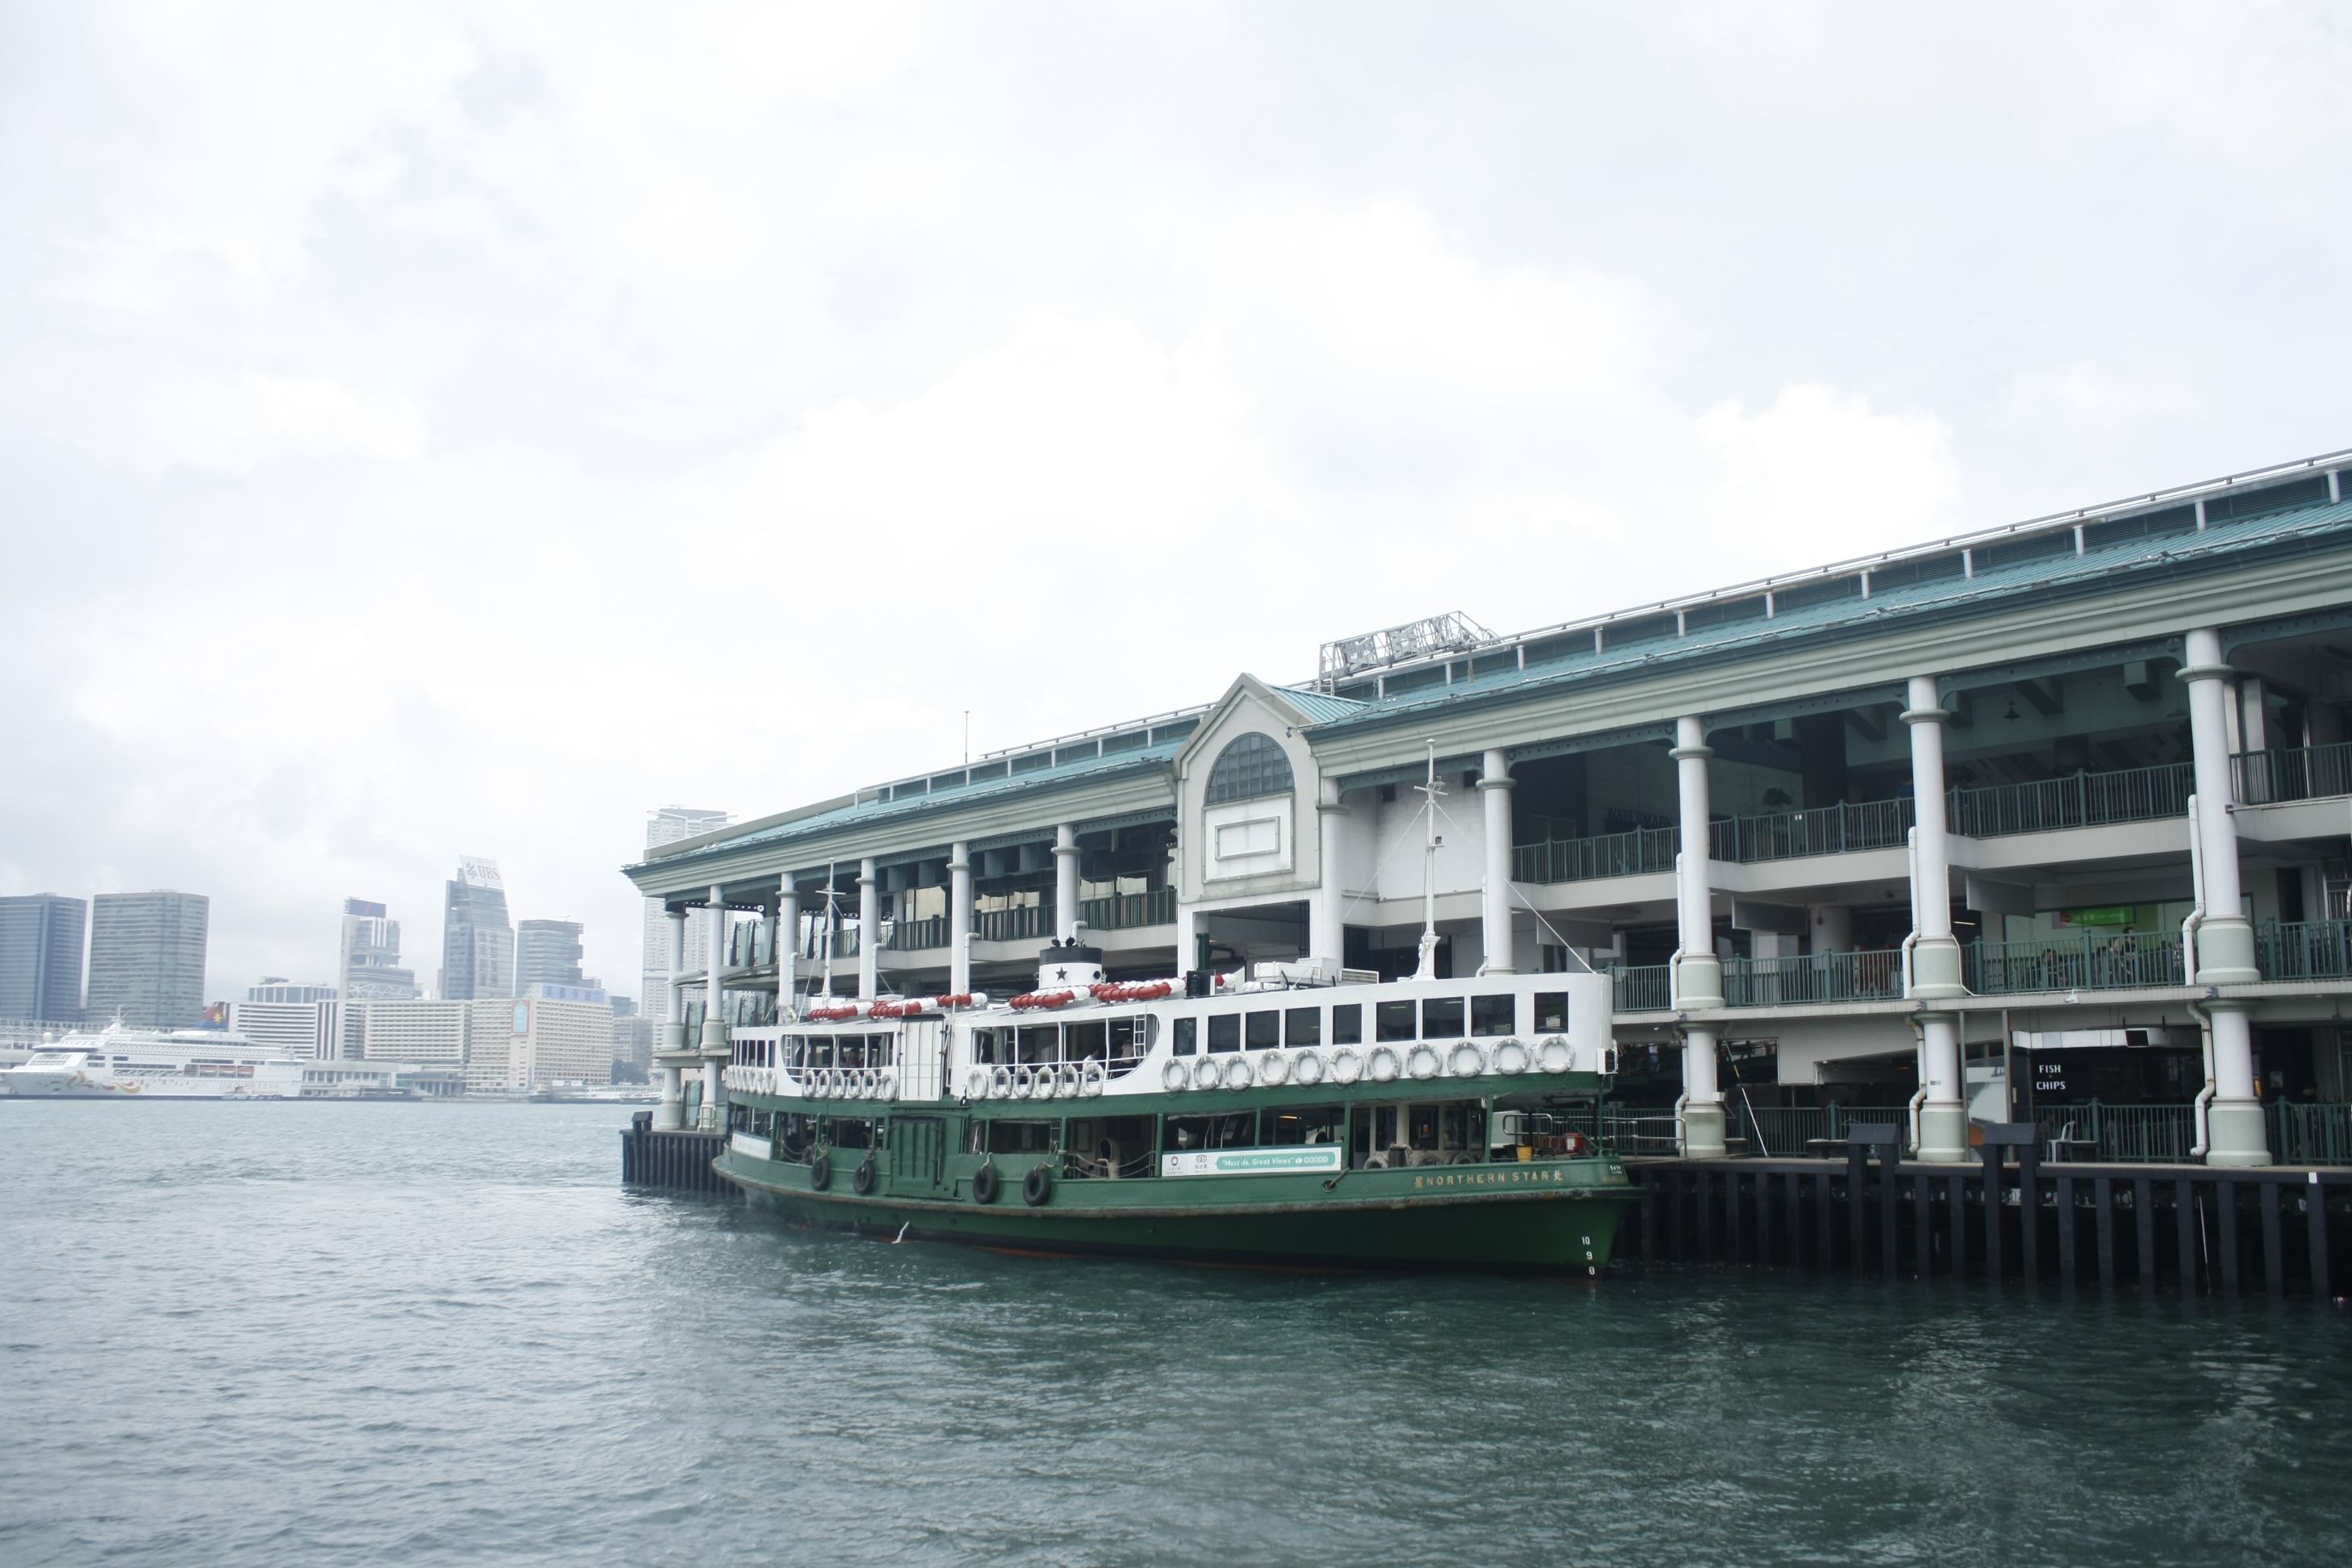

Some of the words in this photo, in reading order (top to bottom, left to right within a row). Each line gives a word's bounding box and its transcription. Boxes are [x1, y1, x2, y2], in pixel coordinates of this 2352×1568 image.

[1606, 807, 1674, 826] WATERMARK
[477, 865, 500, 880] UBS
[2039, 1065, 2061, 1073] FISH
[2036, 1081, 2066, 1090] CHIPS
[1427, 1173, 1506, 1186] NORTHERN
[1512, 1171, 1549, 1182] STAR
[1582, 1236, 1591, 1245] 10
[1586, 1251, 1593, 1260] 9
